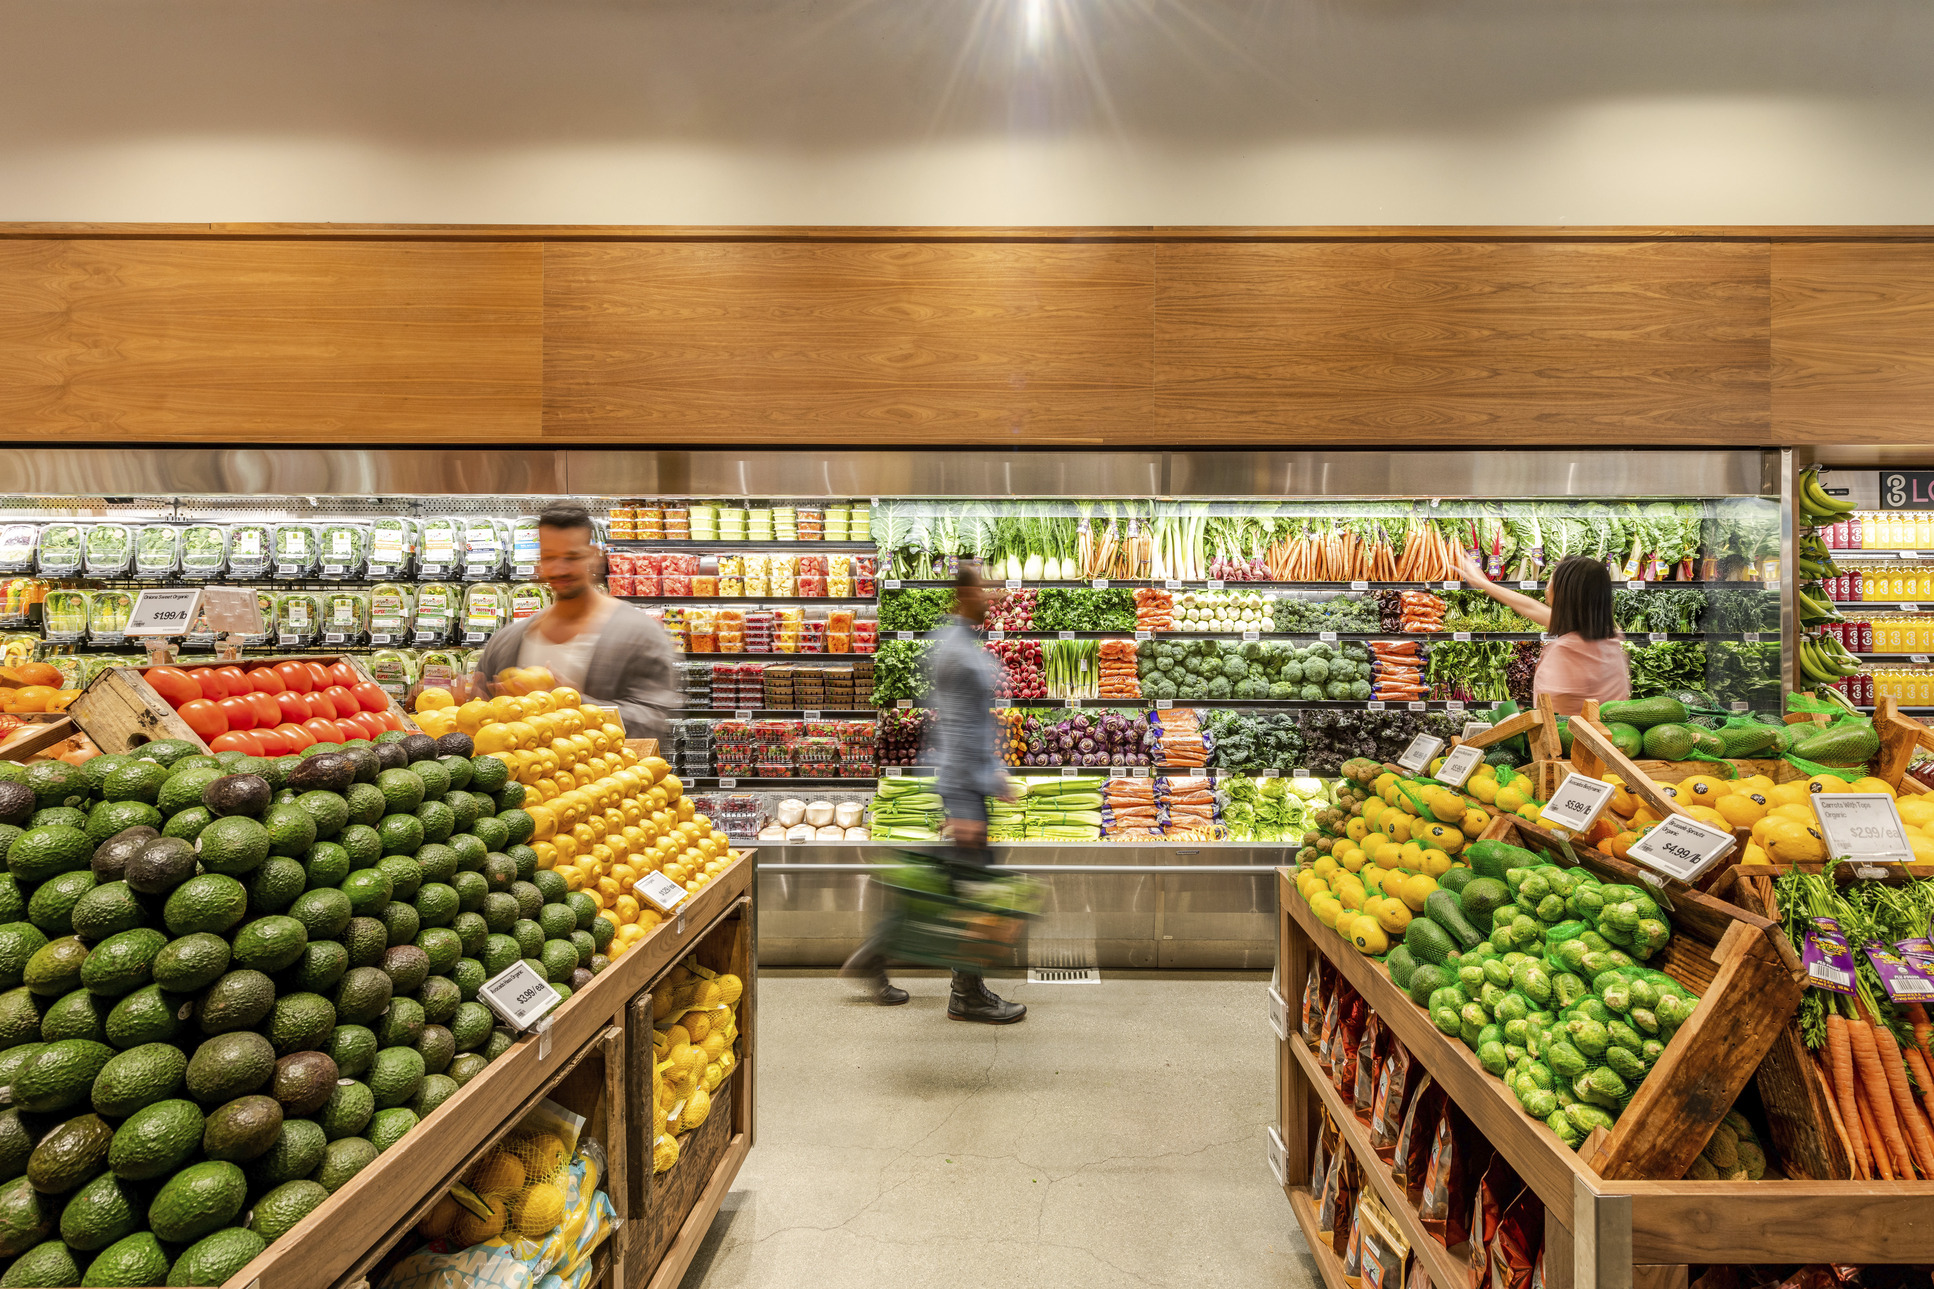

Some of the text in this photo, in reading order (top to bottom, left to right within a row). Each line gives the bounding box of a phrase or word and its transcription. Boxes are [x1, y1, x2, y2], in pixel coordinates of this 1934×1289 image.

[1912, 478, 1934, 502] L
[1565, 799, 1592, 815] $5.99/lb
[1821, 801, 1872, 810] Carrots With Tops
[1825, 811, 1847, 819] Organic
[1661, 827, 1679, 837] Organic
[1850, 826, 1900, 839] $2.99/ea
[1662, 842, 1701, 864] $4.99/lb
[516, 983, 545, 1004] $3.99/ea
